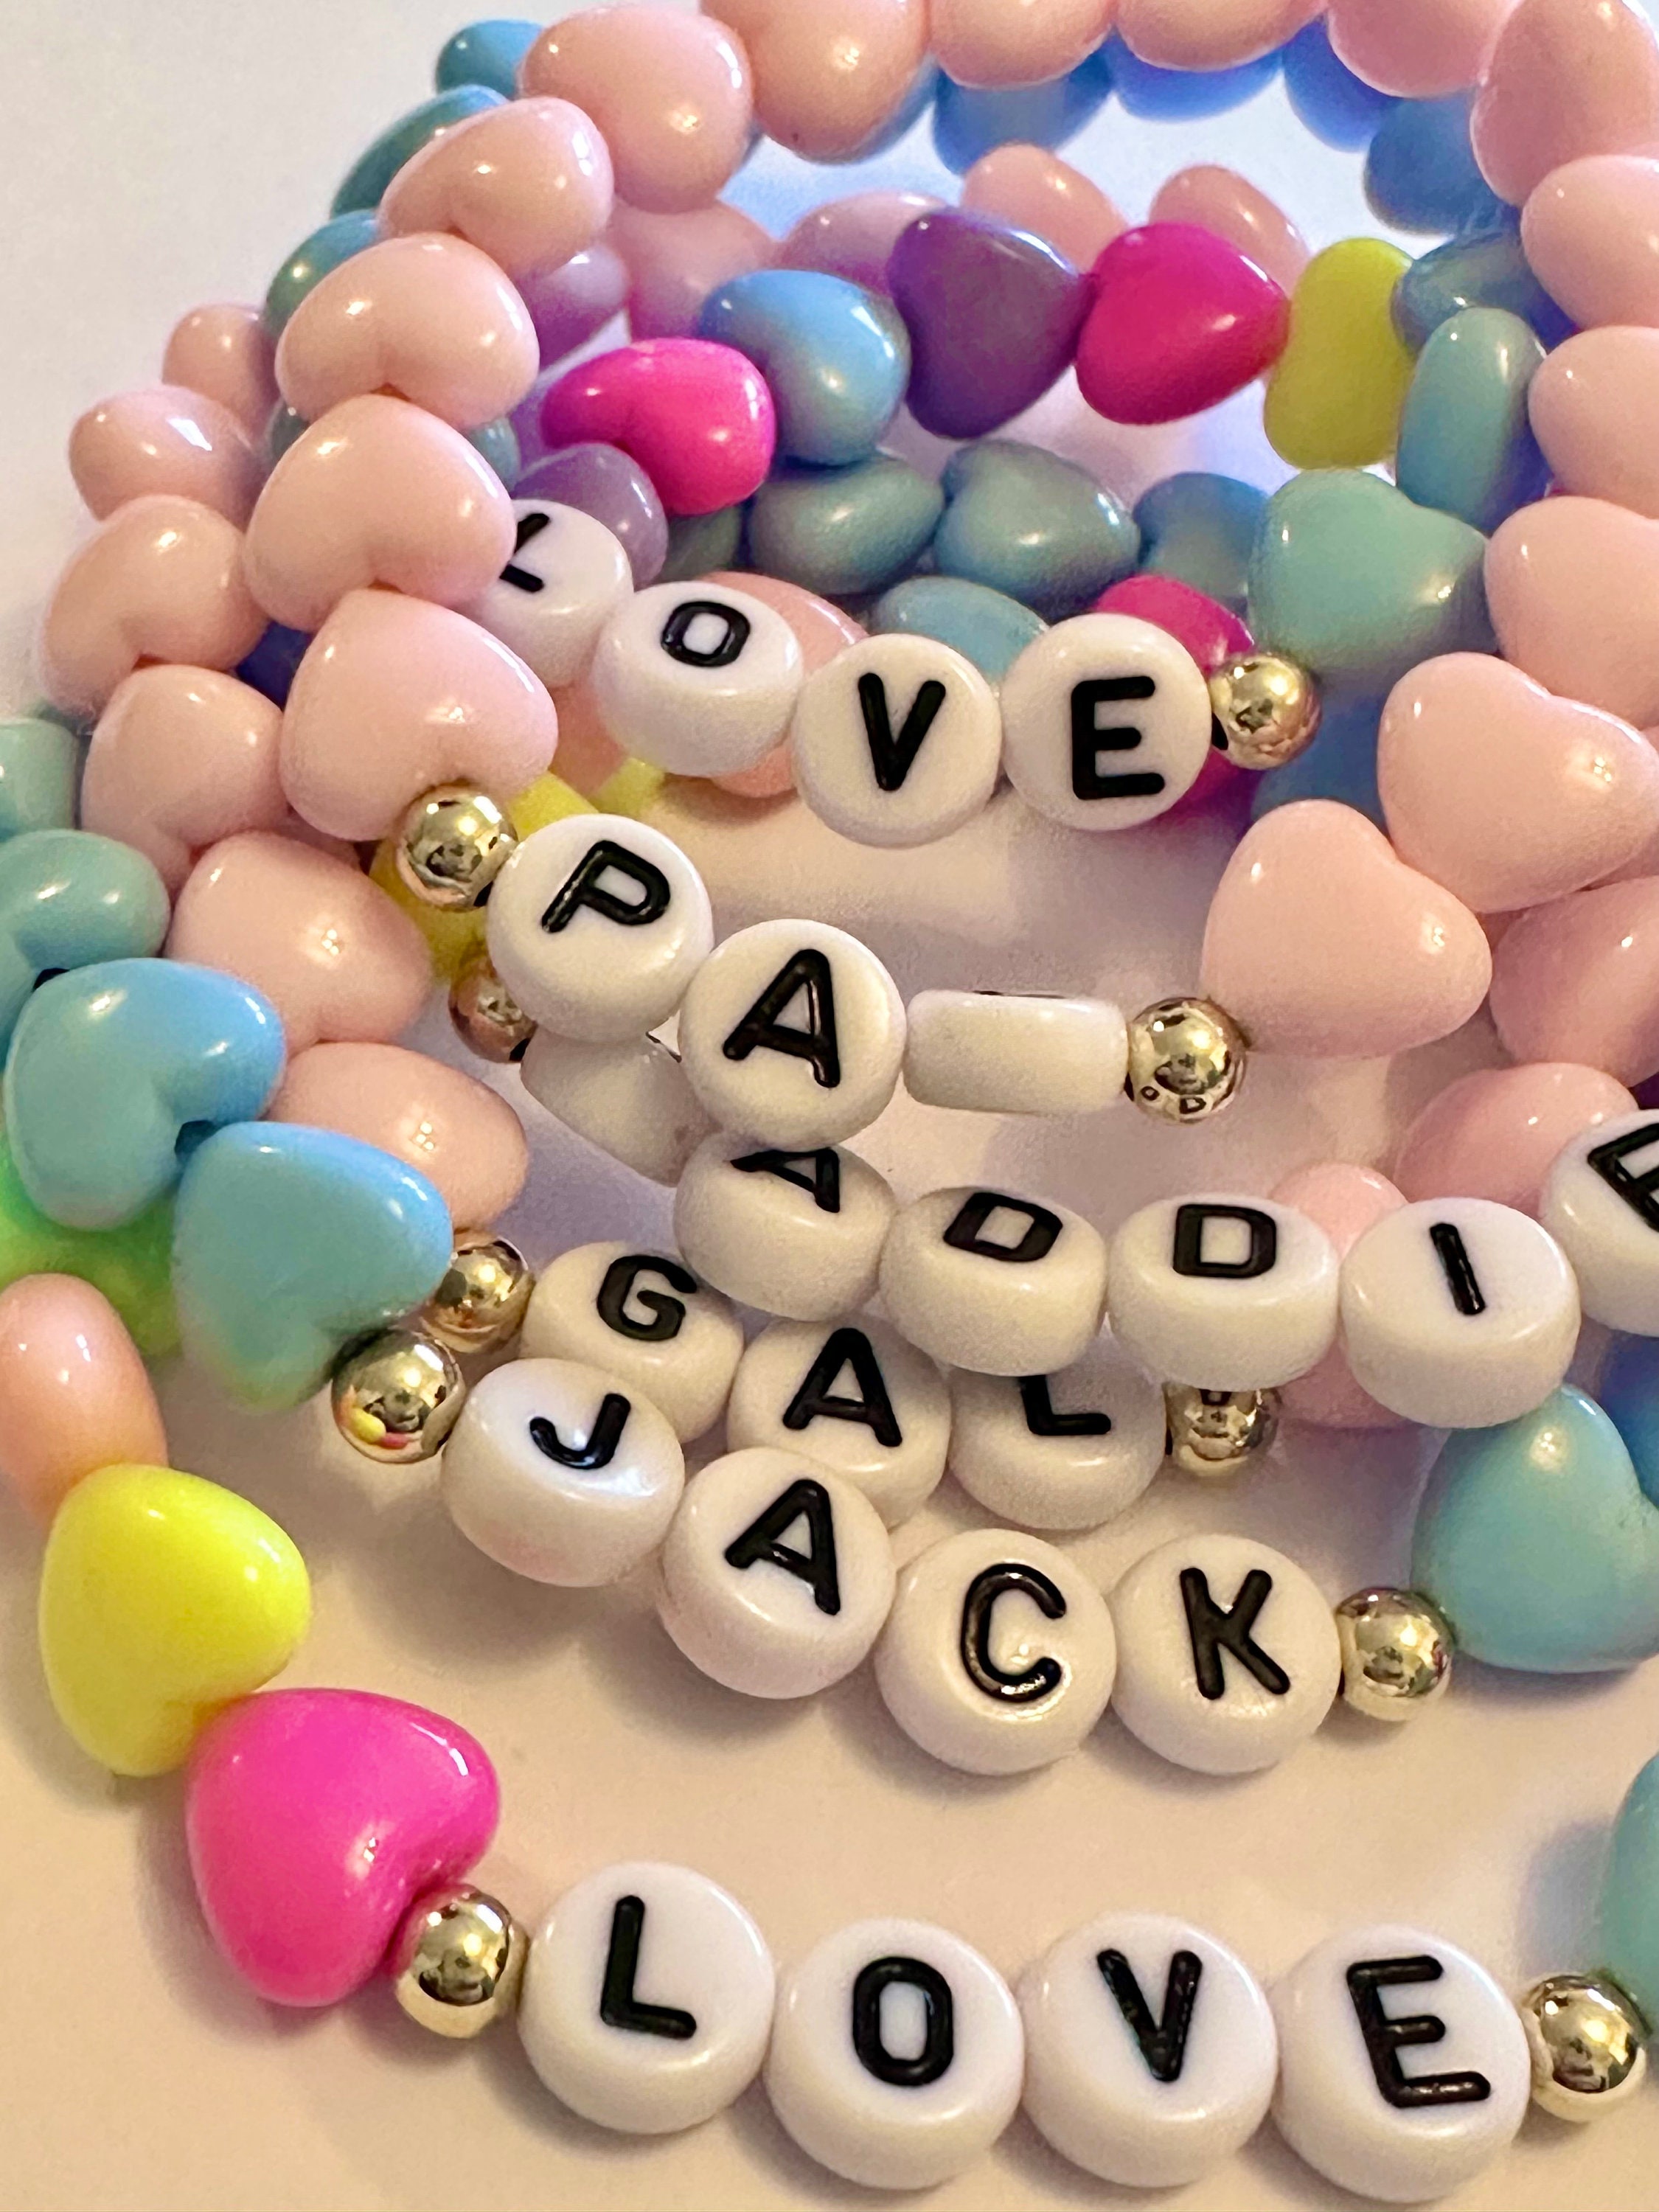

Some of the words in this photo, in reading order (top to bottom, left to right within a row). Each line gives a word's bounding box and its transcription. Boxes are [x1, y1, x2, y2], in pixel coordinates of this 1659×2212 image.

[540, 839, 1066, 1090] PA
[646, 1031, 1659, 1317] ADDIE
[596, 1253, 1113, 1448] GAL
[529, 1392, 1291, 1705] JACK
[598, 1894, 1492, 2110] LOVE
